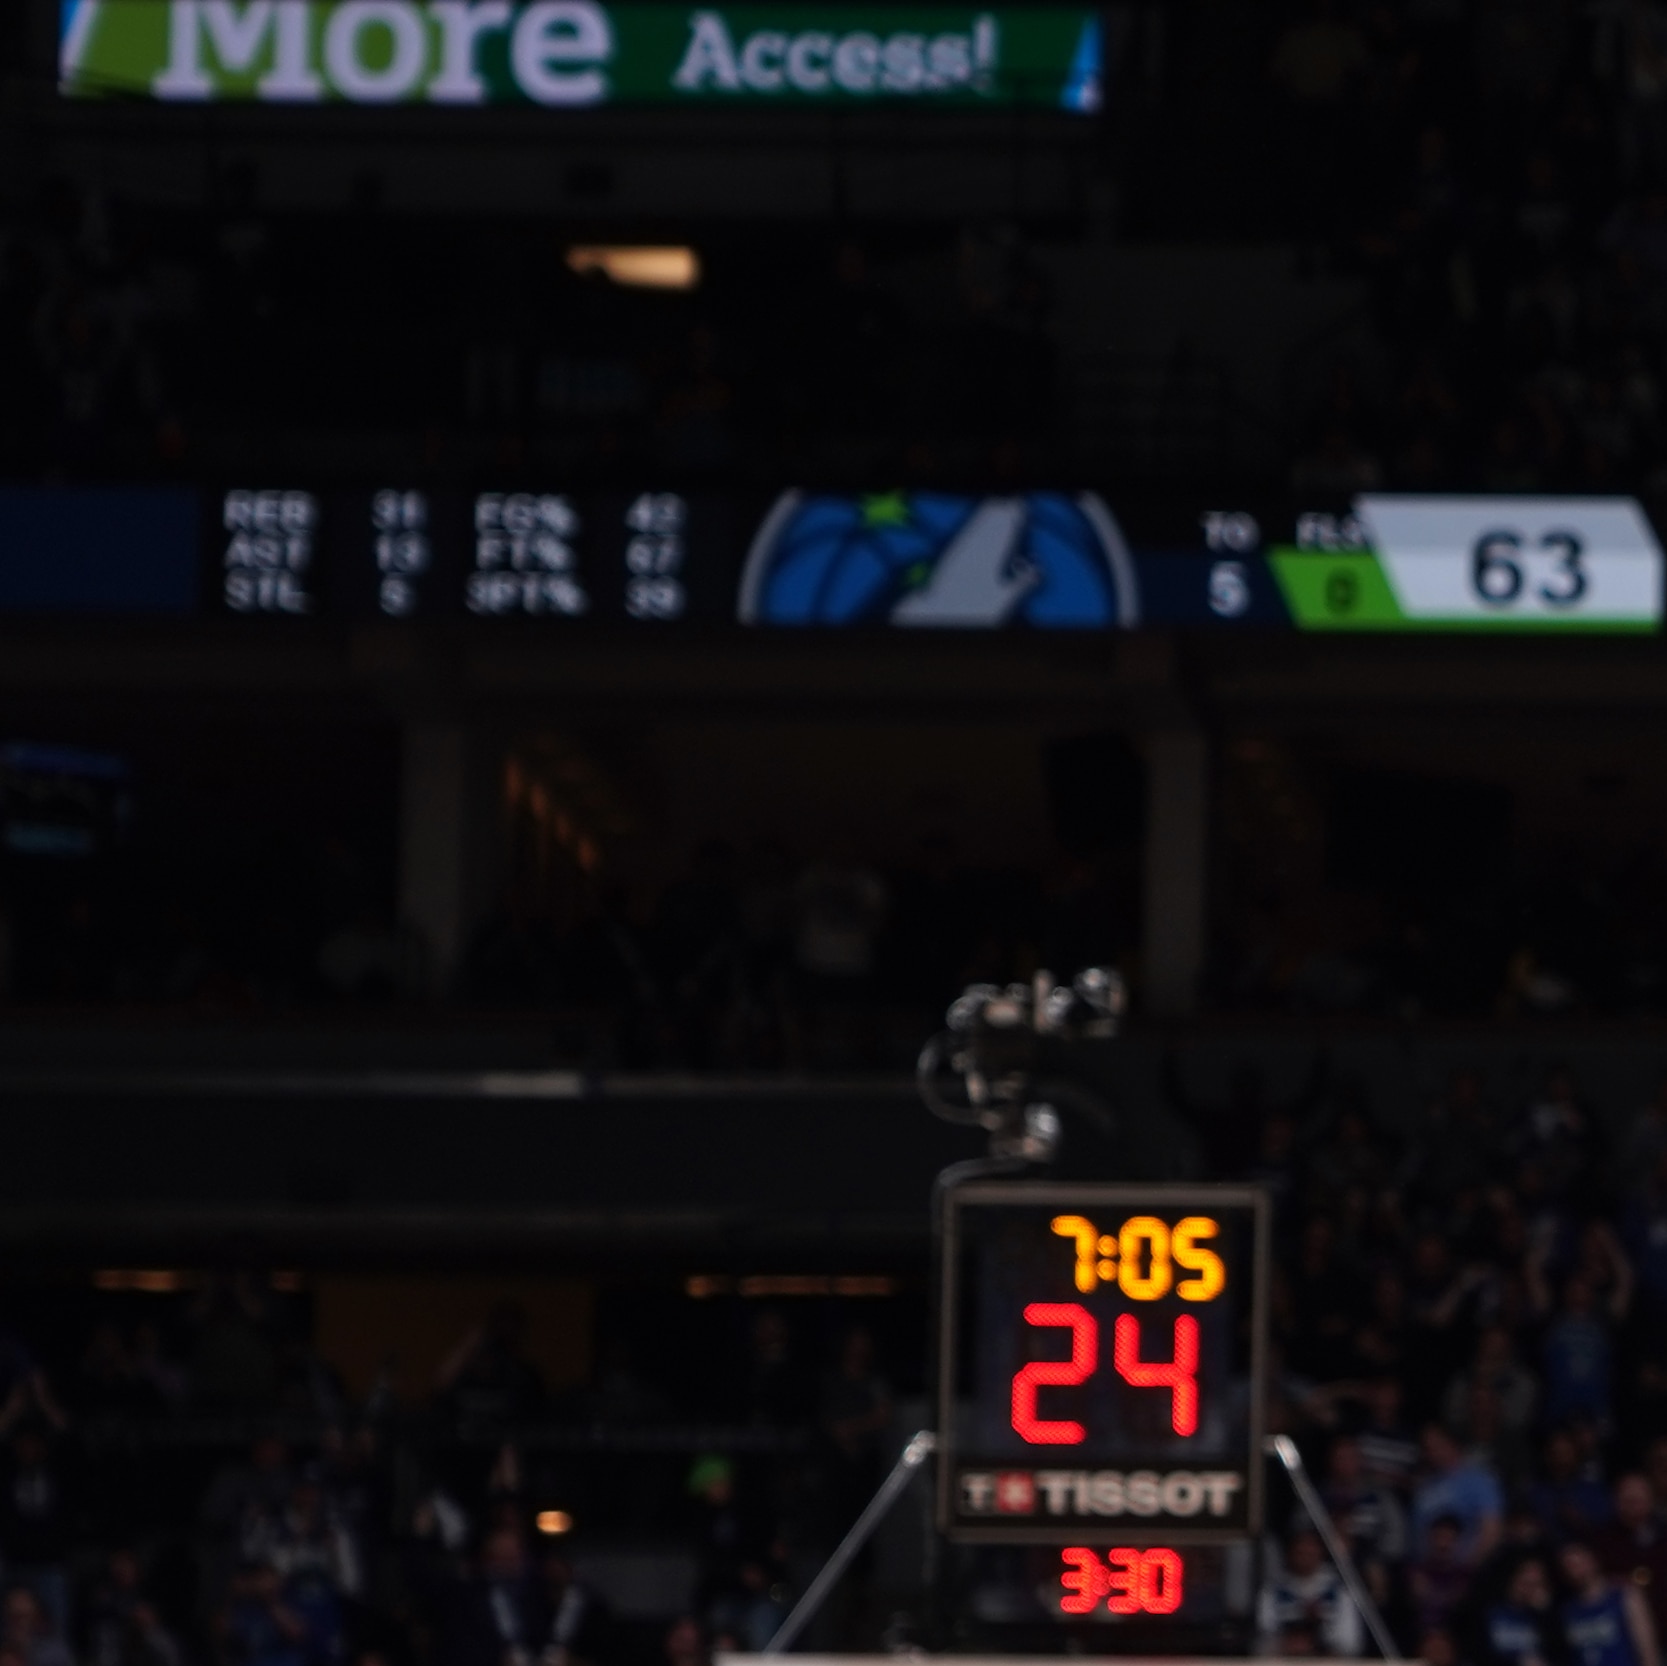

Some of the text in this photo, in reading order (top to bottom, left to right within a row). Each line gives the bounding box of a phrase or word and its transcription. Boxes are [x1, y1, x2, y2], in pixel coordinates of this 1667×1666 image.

[150, 0, 996, 102] More Access!
[1470, 532, 1588, 607] 63
[1050, 1215, 1226, 1301] 7:05
[1011, 1303, 1199, 1445] 24
[1036, 1470, 1244, 1516] TISSOT
